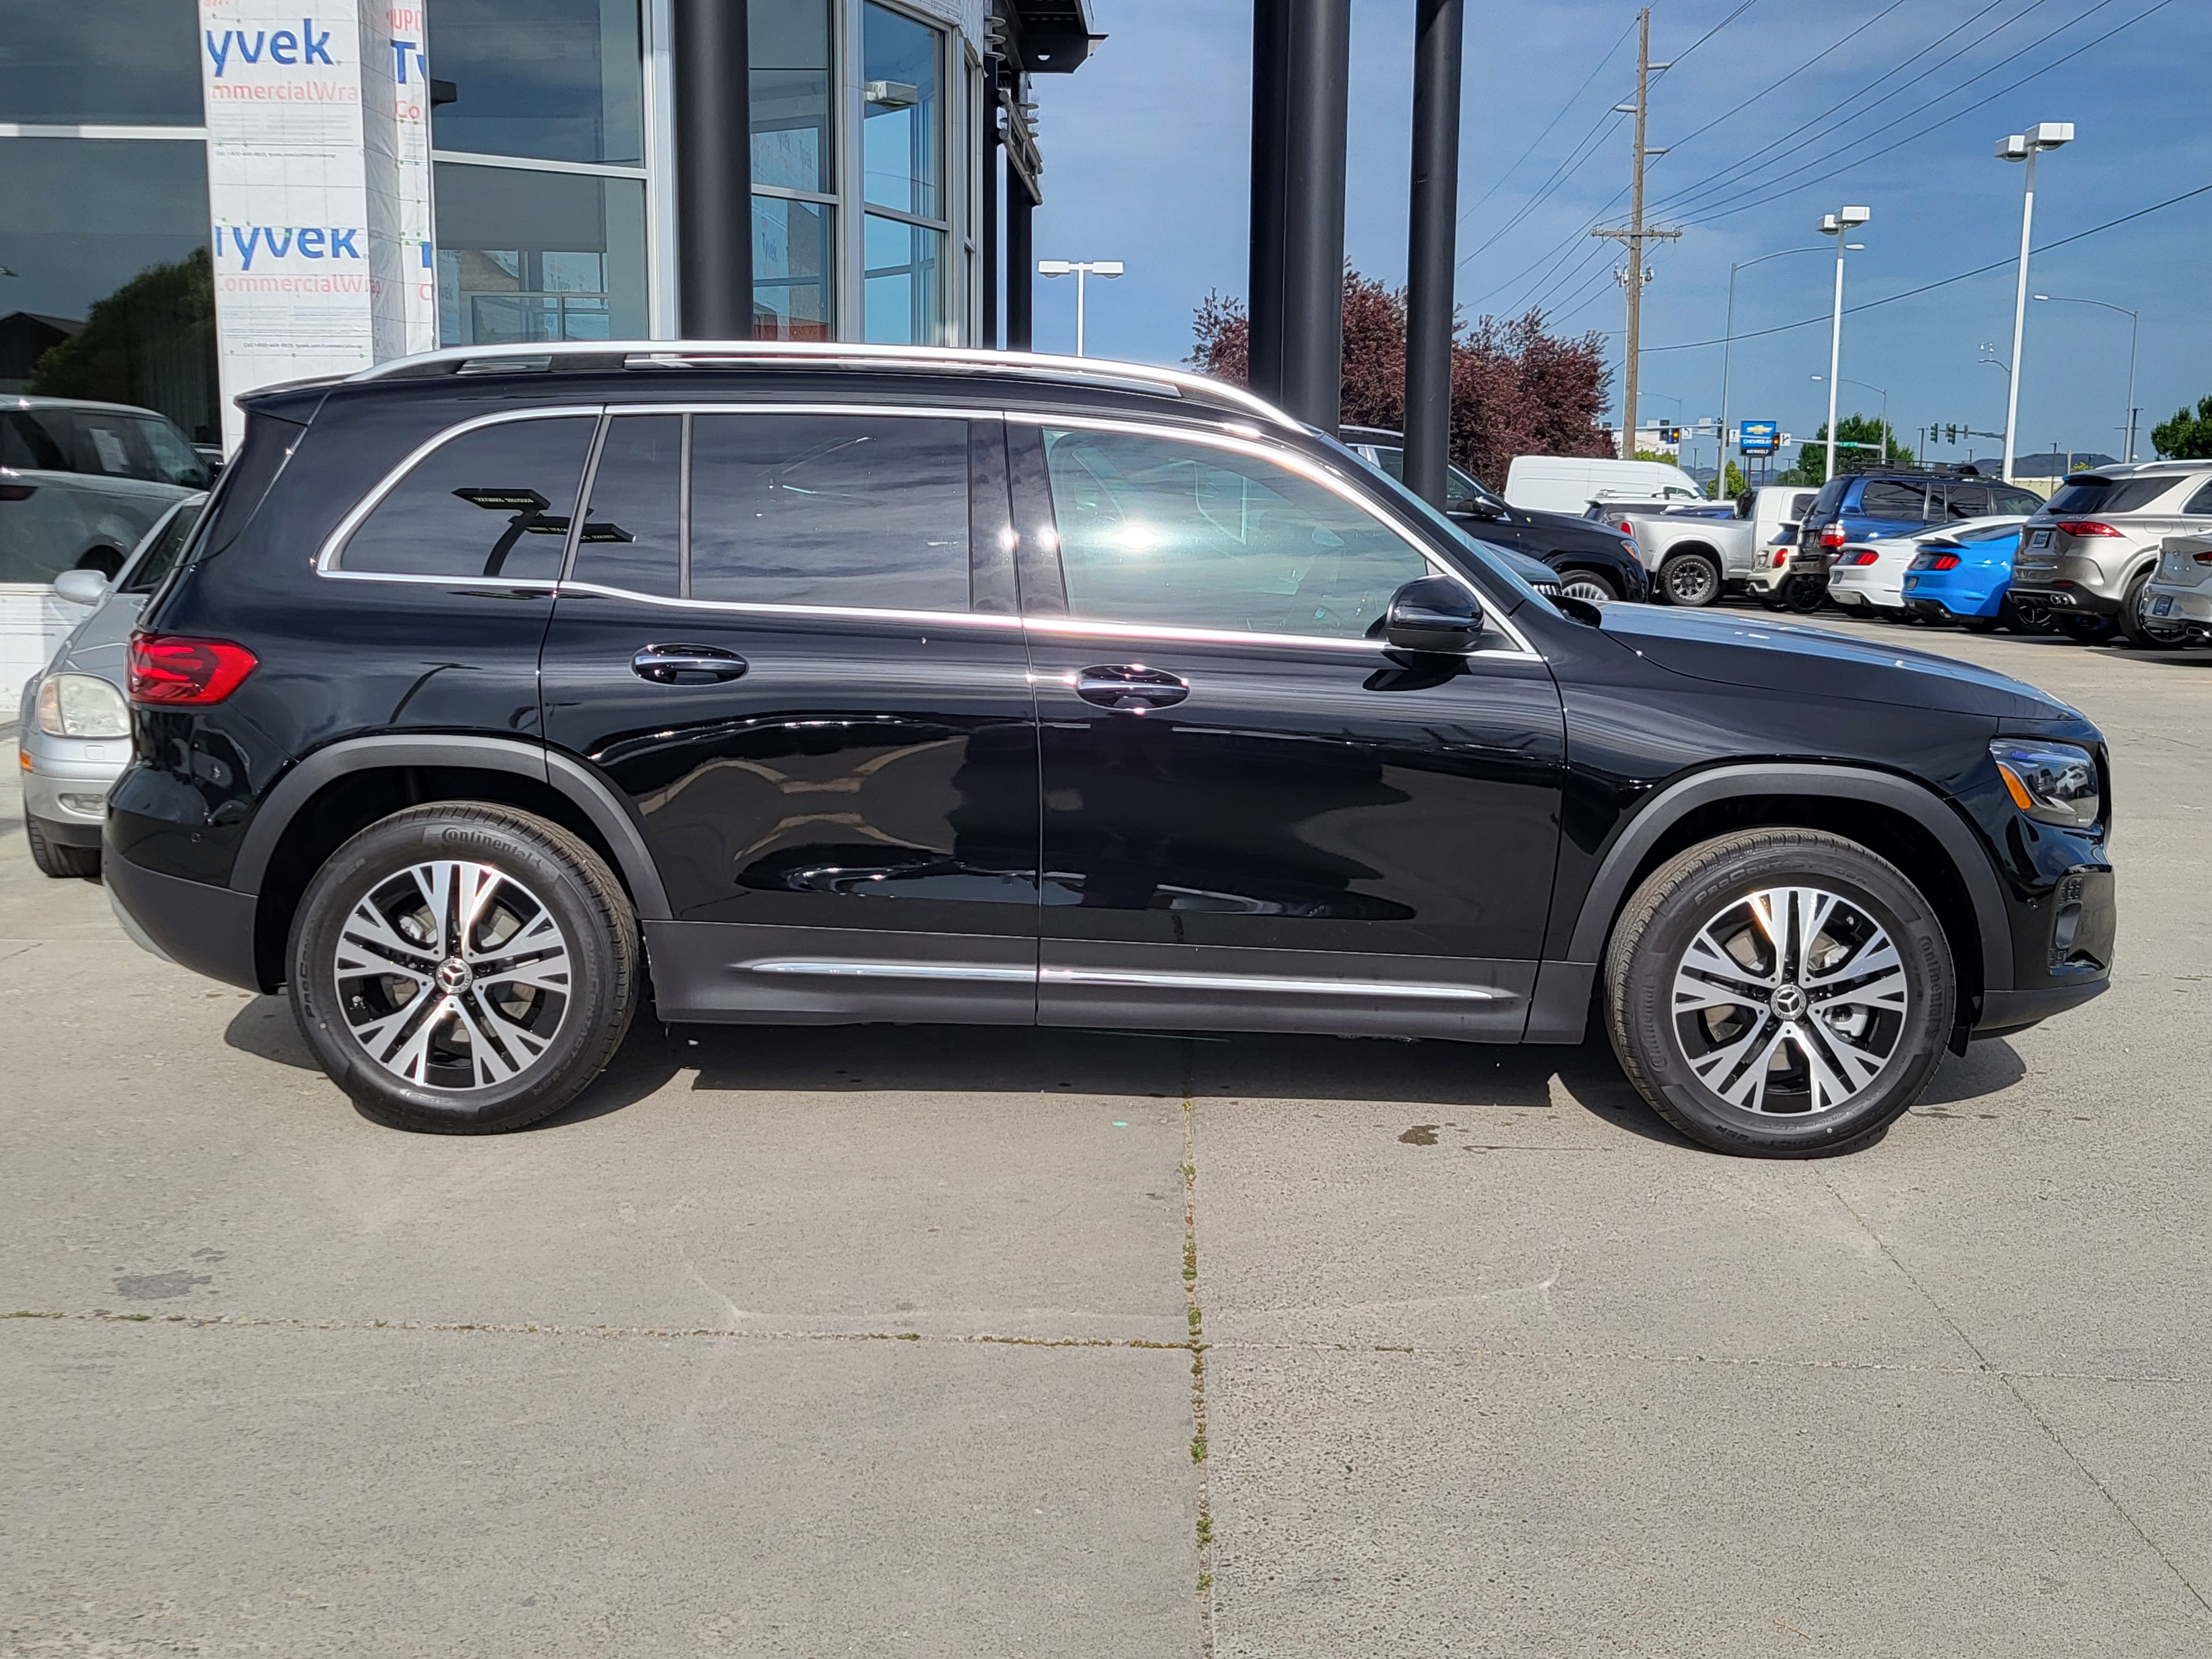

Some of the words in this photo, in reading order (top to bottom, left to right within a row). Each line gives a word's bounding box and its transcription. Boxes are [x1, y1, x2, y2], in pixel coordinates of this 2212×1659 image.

[218, 274, 382, 298] ommercialWrap
[441, 827, 533, 862] Continental
[1918, 935, 1943, 1022] Continental
[1642, 985, 1667, 1072] Continental
